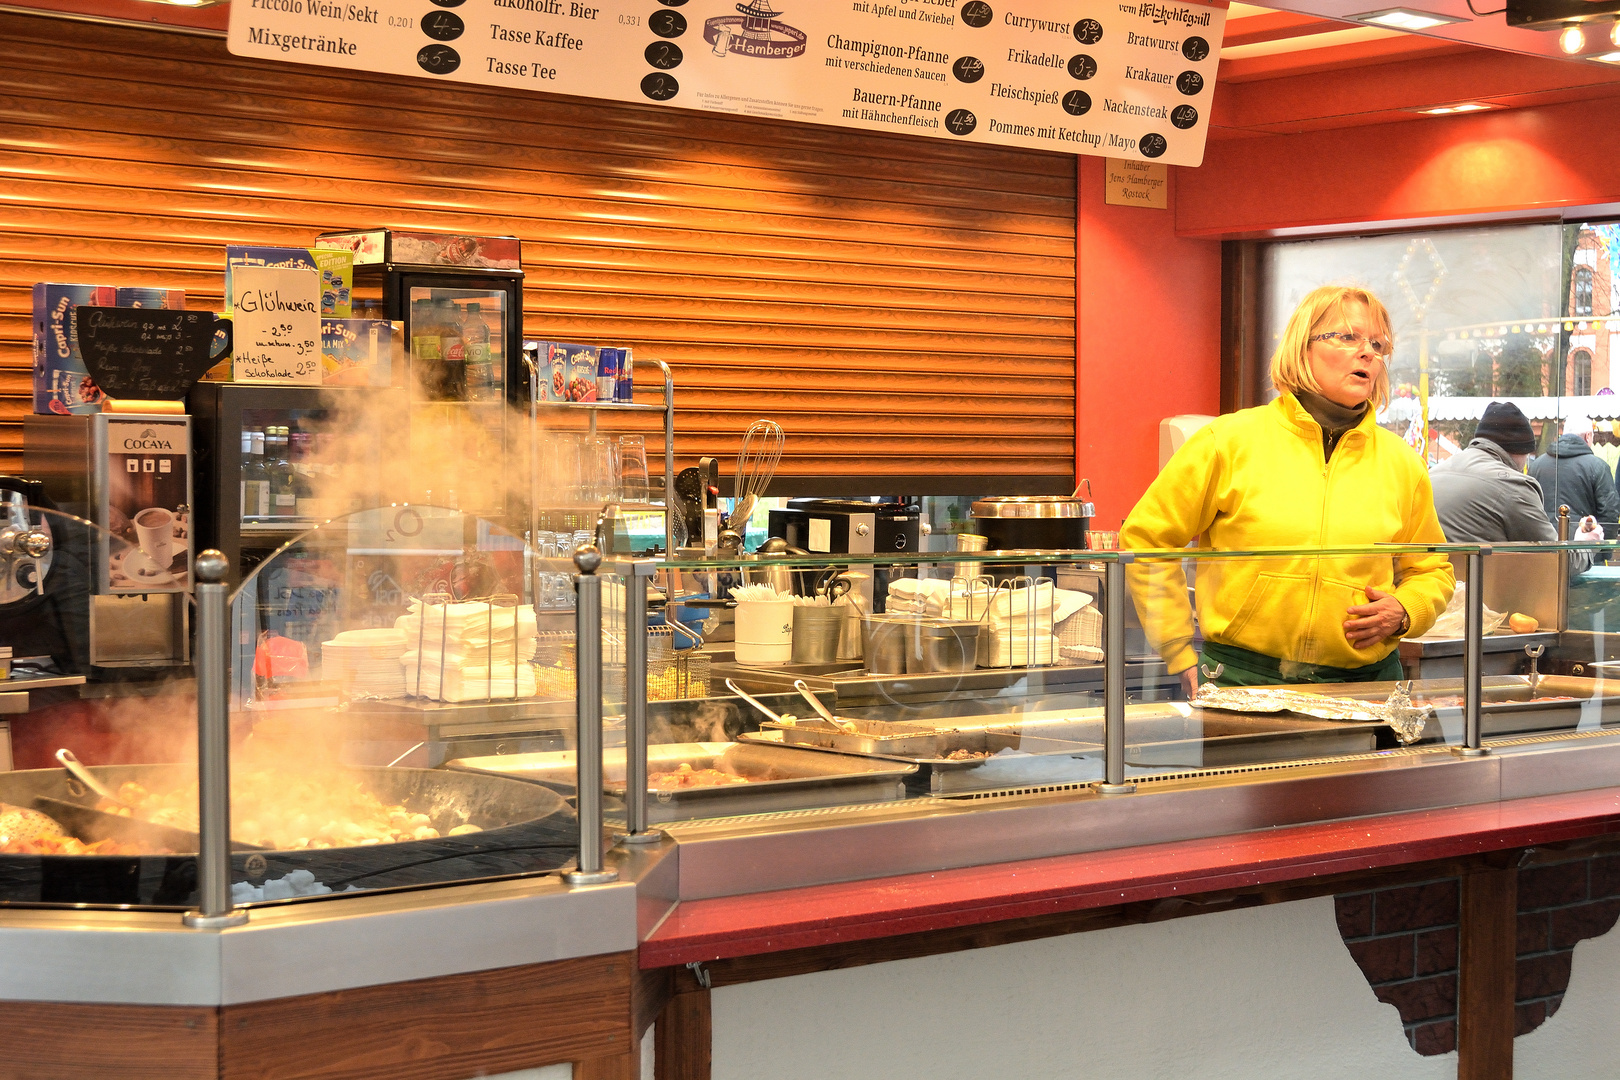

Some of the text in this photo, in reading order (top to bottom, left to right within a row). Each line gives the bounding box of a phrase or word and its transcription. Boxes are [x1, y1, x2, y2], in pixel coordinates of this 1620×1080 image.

[307, 0, 379, 24] Wein/Sekt
[569, 2, 599, 20] Bier
[852, 1, 955, 26] mit Apfel und Zwiebel
[1118, 3, 1211, 27] vom Holzkohlegrill
[1004, 12, 1071, 35] Currywurst
[248, 27, 357, 56] Mixgetränke
[490, 24, 583, 51] Tasse Kaffee
[733, 38, 806, 58] Hamberger
[1127, 31, 1180, 52] Bratwurst
[827, 34, 949, 64] Champignon-Pfanne
[1007, 48, 1065, 69] Frikadelle
[486, 57, 557, 80] Tasse Tee
[825, 56, 946, 82] mit verschiedenen Saucen
[1124, 66, 1174, 85] Krakauer
[852, 87, 942, 112] Bauern-Pfanne
[990, 83, 1059, 105] Fleischspieß
[842, 107, 939, 129] mit Hähnchenfleisch
[1102, 98, 1168, 120] Nackensteak
[988, 118, 1035, 137] Pommes
[1037, 125, 1055, 140] mit
[1058, 127, 1101, 148] Ketchup
[1108, 134, 1136, 151] Mayo
[1123, 160, 1151, 172] Inhaber
[1108, 172, 1164, 190] Jens Hamberger
[1122, 187, 1151, 201] Rostock
[319, 255, 347, 268] EDITION
[240, 289, 317, 313] Glühwein
[50, 296, 71, 358] Capri-Sun
[321, 322, 357, 341] ri-Sun
[242, 351, 275, 368] Heiße
[244, 368, 295, 379] Schokolade
[123, 438, 172, 450] COCAYA
